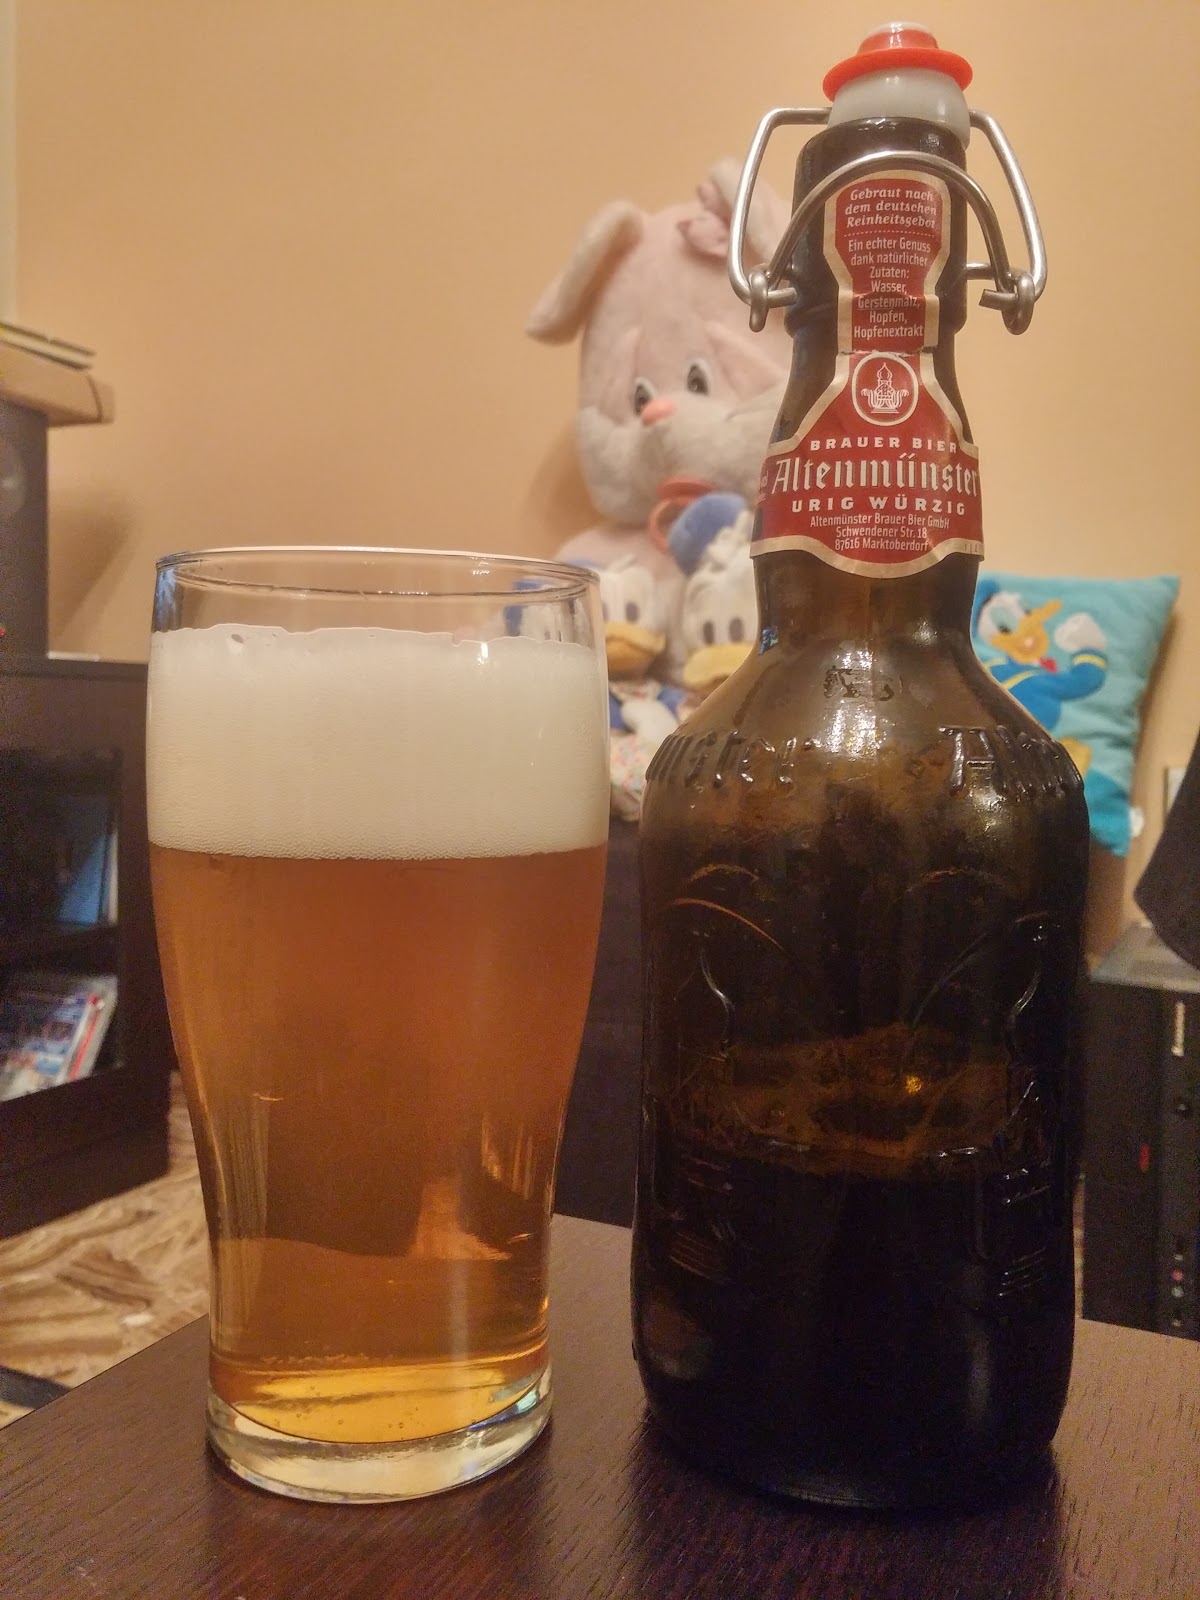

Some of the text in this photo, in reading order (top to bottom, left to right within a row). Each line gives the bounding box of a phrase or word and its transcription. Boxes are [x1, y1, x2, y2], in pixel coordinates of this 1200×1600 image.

[850, 188, 934, 202] Gebraut nach
[845, 200, 937, 216] dem deutschen
[846, 214, 936, 229] Reinheitsgebot
[848, 237, 931, 253] Ein echter Genuss
[850, 251, 928, 267] dank natürlicher
[869, 266, 910, 279] Zutaten:
[871, 280, 907, 295] Wasser,
[858, 295, 920, 309] Gerstenmalz,
[869, 309, 908, 325] Hopfen,
[854, 325, 924, 340] Hopfenextrakt
[810, 436, 957, 454] BRAUER BIER
[771, 452, 978, 497] Altenmünster
[791, 493, 966, 516] URIG WÜRZIG
[809, 512, 950, 529] Altenmünster Brauer Bier GmbH
[835, 526, 928, 539] Schwendener Str. 18
[835, 537, 929, 552] 87616 Marktoberdorf
